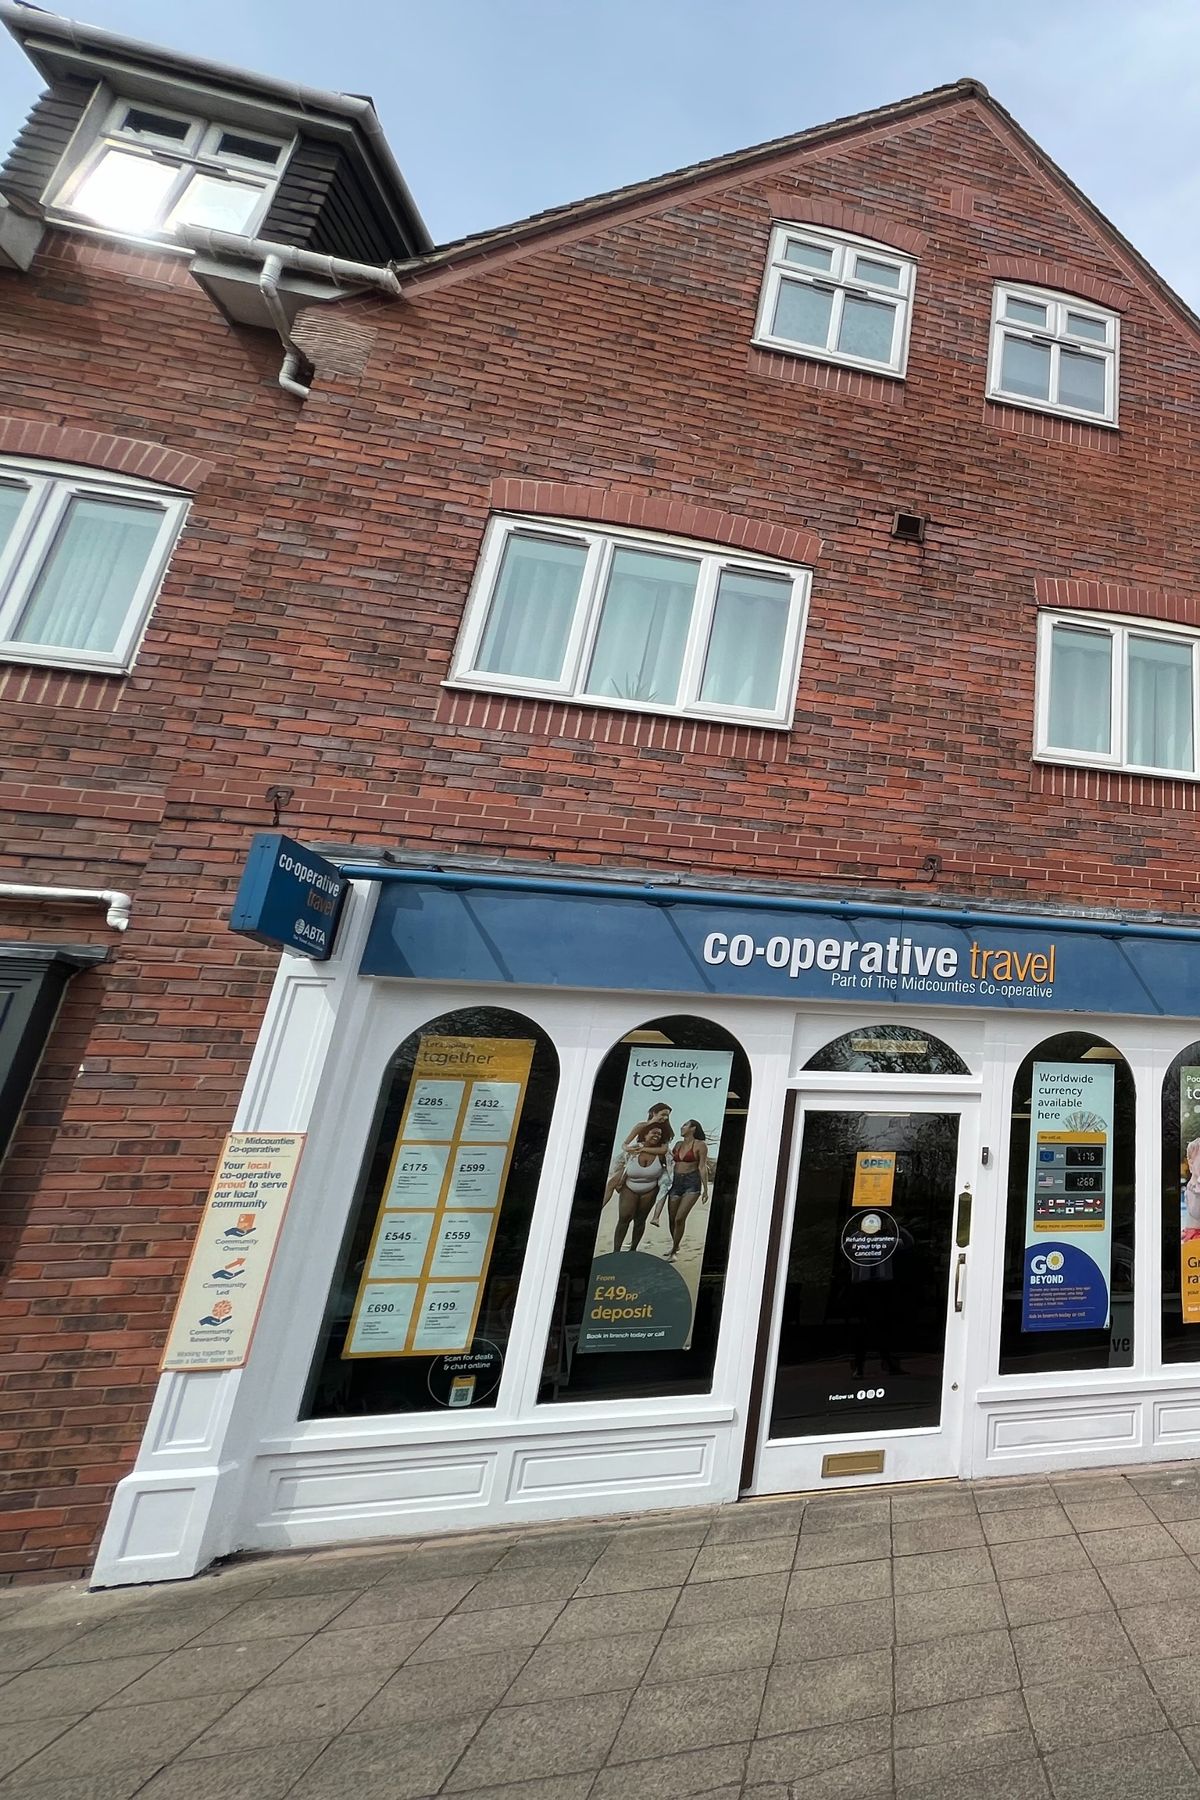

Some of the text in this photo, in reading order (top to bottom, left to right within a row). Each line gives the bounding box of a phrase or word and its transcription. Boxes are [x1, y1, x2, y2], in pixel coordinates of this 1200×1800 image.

[279, 853, 340, 897] co-operative
[303, 924, 325, 945] ABTA
[703, 932, 1055, 983] co-operative travel
[831, 972, 1053, 998] Part of The Midcounties Co-operative
[423, 1052, 495, 1066] together
[636, 1059, 658, 1067] Let's
[633, 1071, 722, 1091] together
[1039, 1073, 1094, 1084] Worldwide
[1039, 1087, 1082, 1097] currency
[418, 1098, 443, 1106] £285
[474, 1100, 499, 1108] £432
[1038, 1098, 1082, 1107] available
[1037, 1110, 1060, 1119] here
[245, 1137, 295, 1146] Midcounties
[229, 1146, 280, 1154] Co-operative
[223, 1162, 271, 1170] Your local
[402, 1163, 428, 1171] £175
[460, 1164, 485, 1172] £599
[220, 1171, 281, 1180] co-operative
[216, 1181, 246, 1190] proud
[233, 1190, 257, 1198] local
[211, 1200, 267, 1209] community
[385, 1232, 411, 1240] £545
[445, 1231, 470, 1240] £559
[1030, 1275, 1063, 1284] BEYOND
[367, 1304, 394, 1312] £690
[429, 1302, 456, 1311] £199
[591, 1304, 654, 1322] deposit
[474, 1353, 493, 1361] deals
